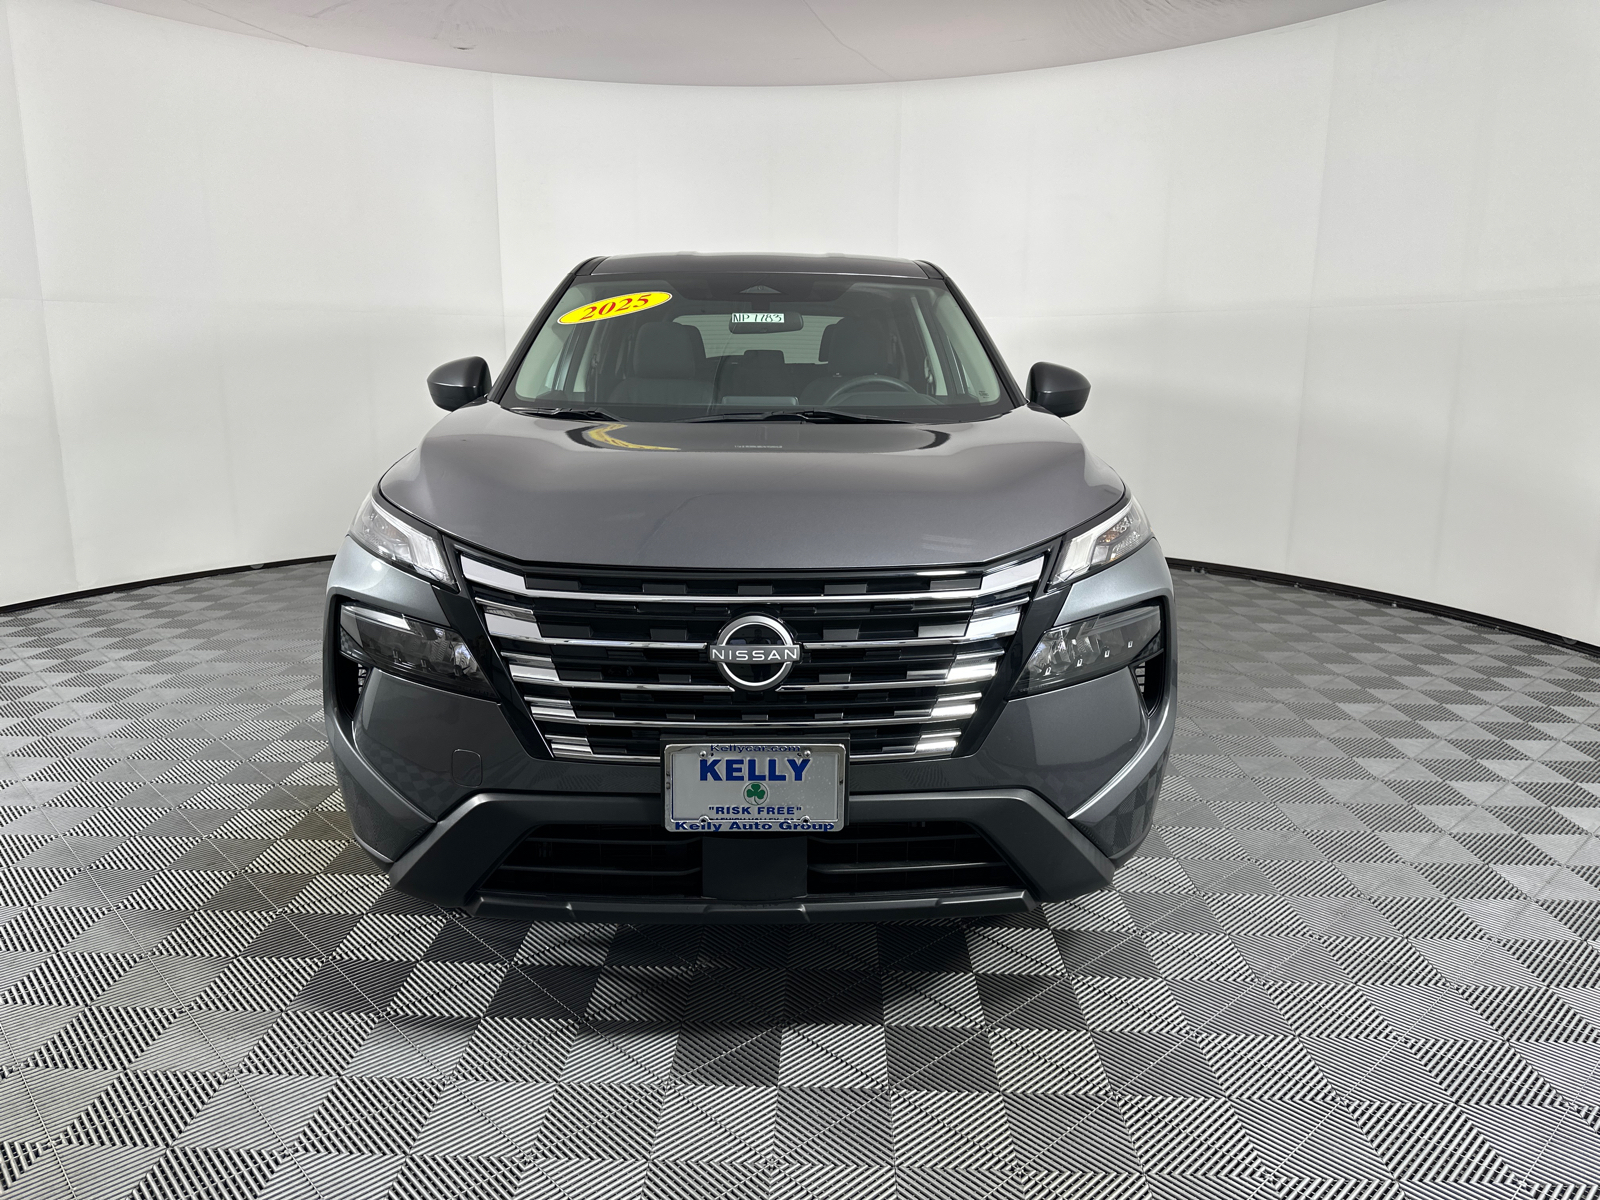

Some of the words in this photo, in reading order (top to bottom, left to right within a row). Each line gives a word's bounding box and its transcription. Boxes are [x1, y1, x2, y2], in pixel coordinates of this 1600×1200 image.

[579, 294, 652, 321] 2025
[712, 648, 797, 661] NISSAN
[710, 744, 801, 753] Kellycar.com
[700, 759, 811, 781] KELLY
[708, 806, 752, 815] "RISK
[757, 806, 802, 815] FREE"
[675, 821, 721, 832] Kelly
[729, 821, 773, 831] Auto
[779, 821, 835, 832] Group
